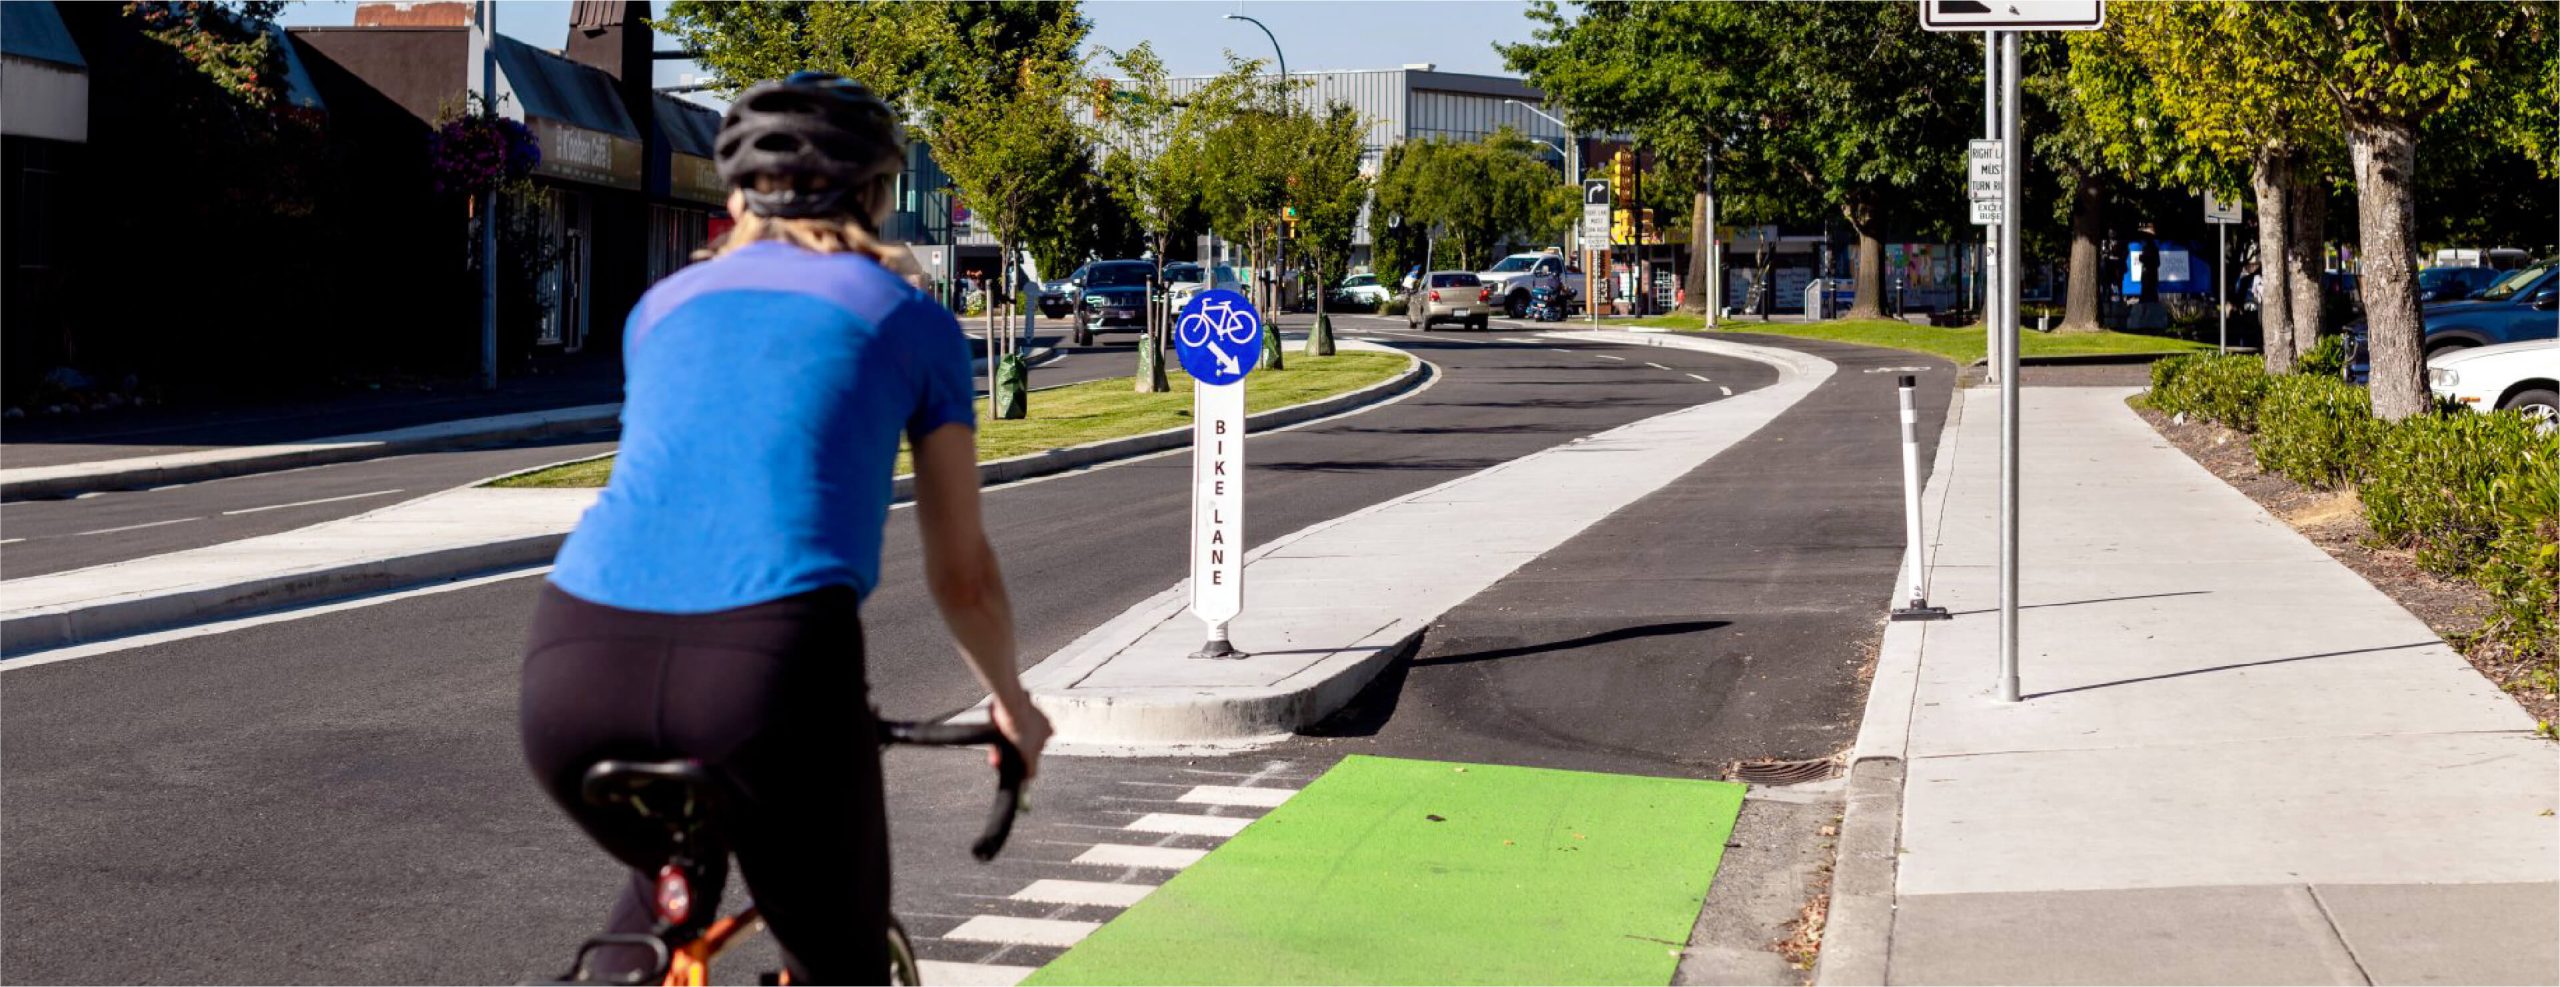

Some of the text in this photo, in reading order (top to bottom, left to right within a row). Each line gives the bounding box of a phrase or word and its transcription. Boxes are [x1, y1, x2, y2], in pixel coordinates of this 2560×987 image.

[1973, 148, 1992, 159] RIGHT
[1981, 164, 2001, 175] MUS
[1973, 180, 1990, 191] TURN
[1979, 212, 2001, 220] BUSE
[1212, 420, 1226, 585] BIKE LANE
